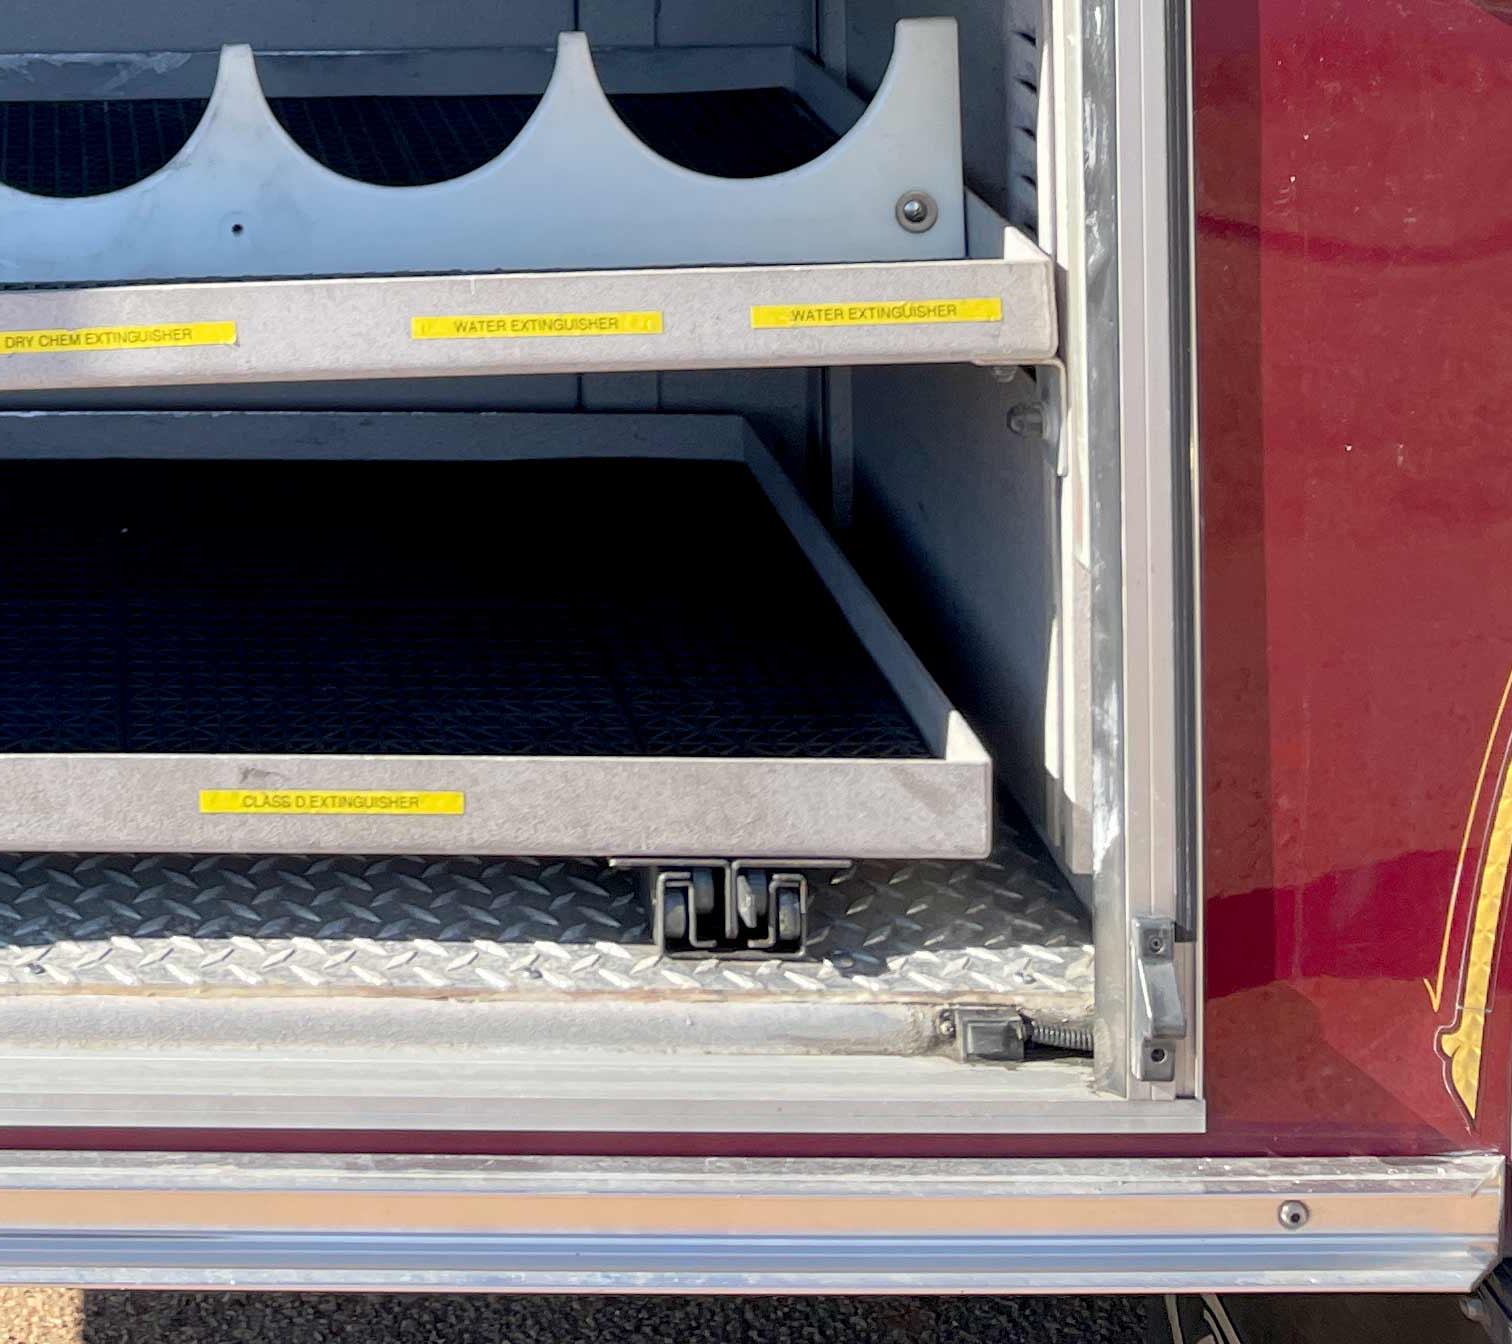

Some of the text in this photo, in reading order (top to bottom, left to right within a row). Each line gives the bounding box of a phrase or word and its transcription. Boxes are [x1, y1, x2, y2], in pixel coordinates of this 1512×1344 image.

[791, 303, 957, 322] WATER EXTINGUISHER
[454, 317, 618, 333] WATER EXTINGUISHER
[4, 327, 193, 349] DRY CHEM EXTINGUISHER
[242, 795, 420, 809] CLASS D EXTINGUISHER
